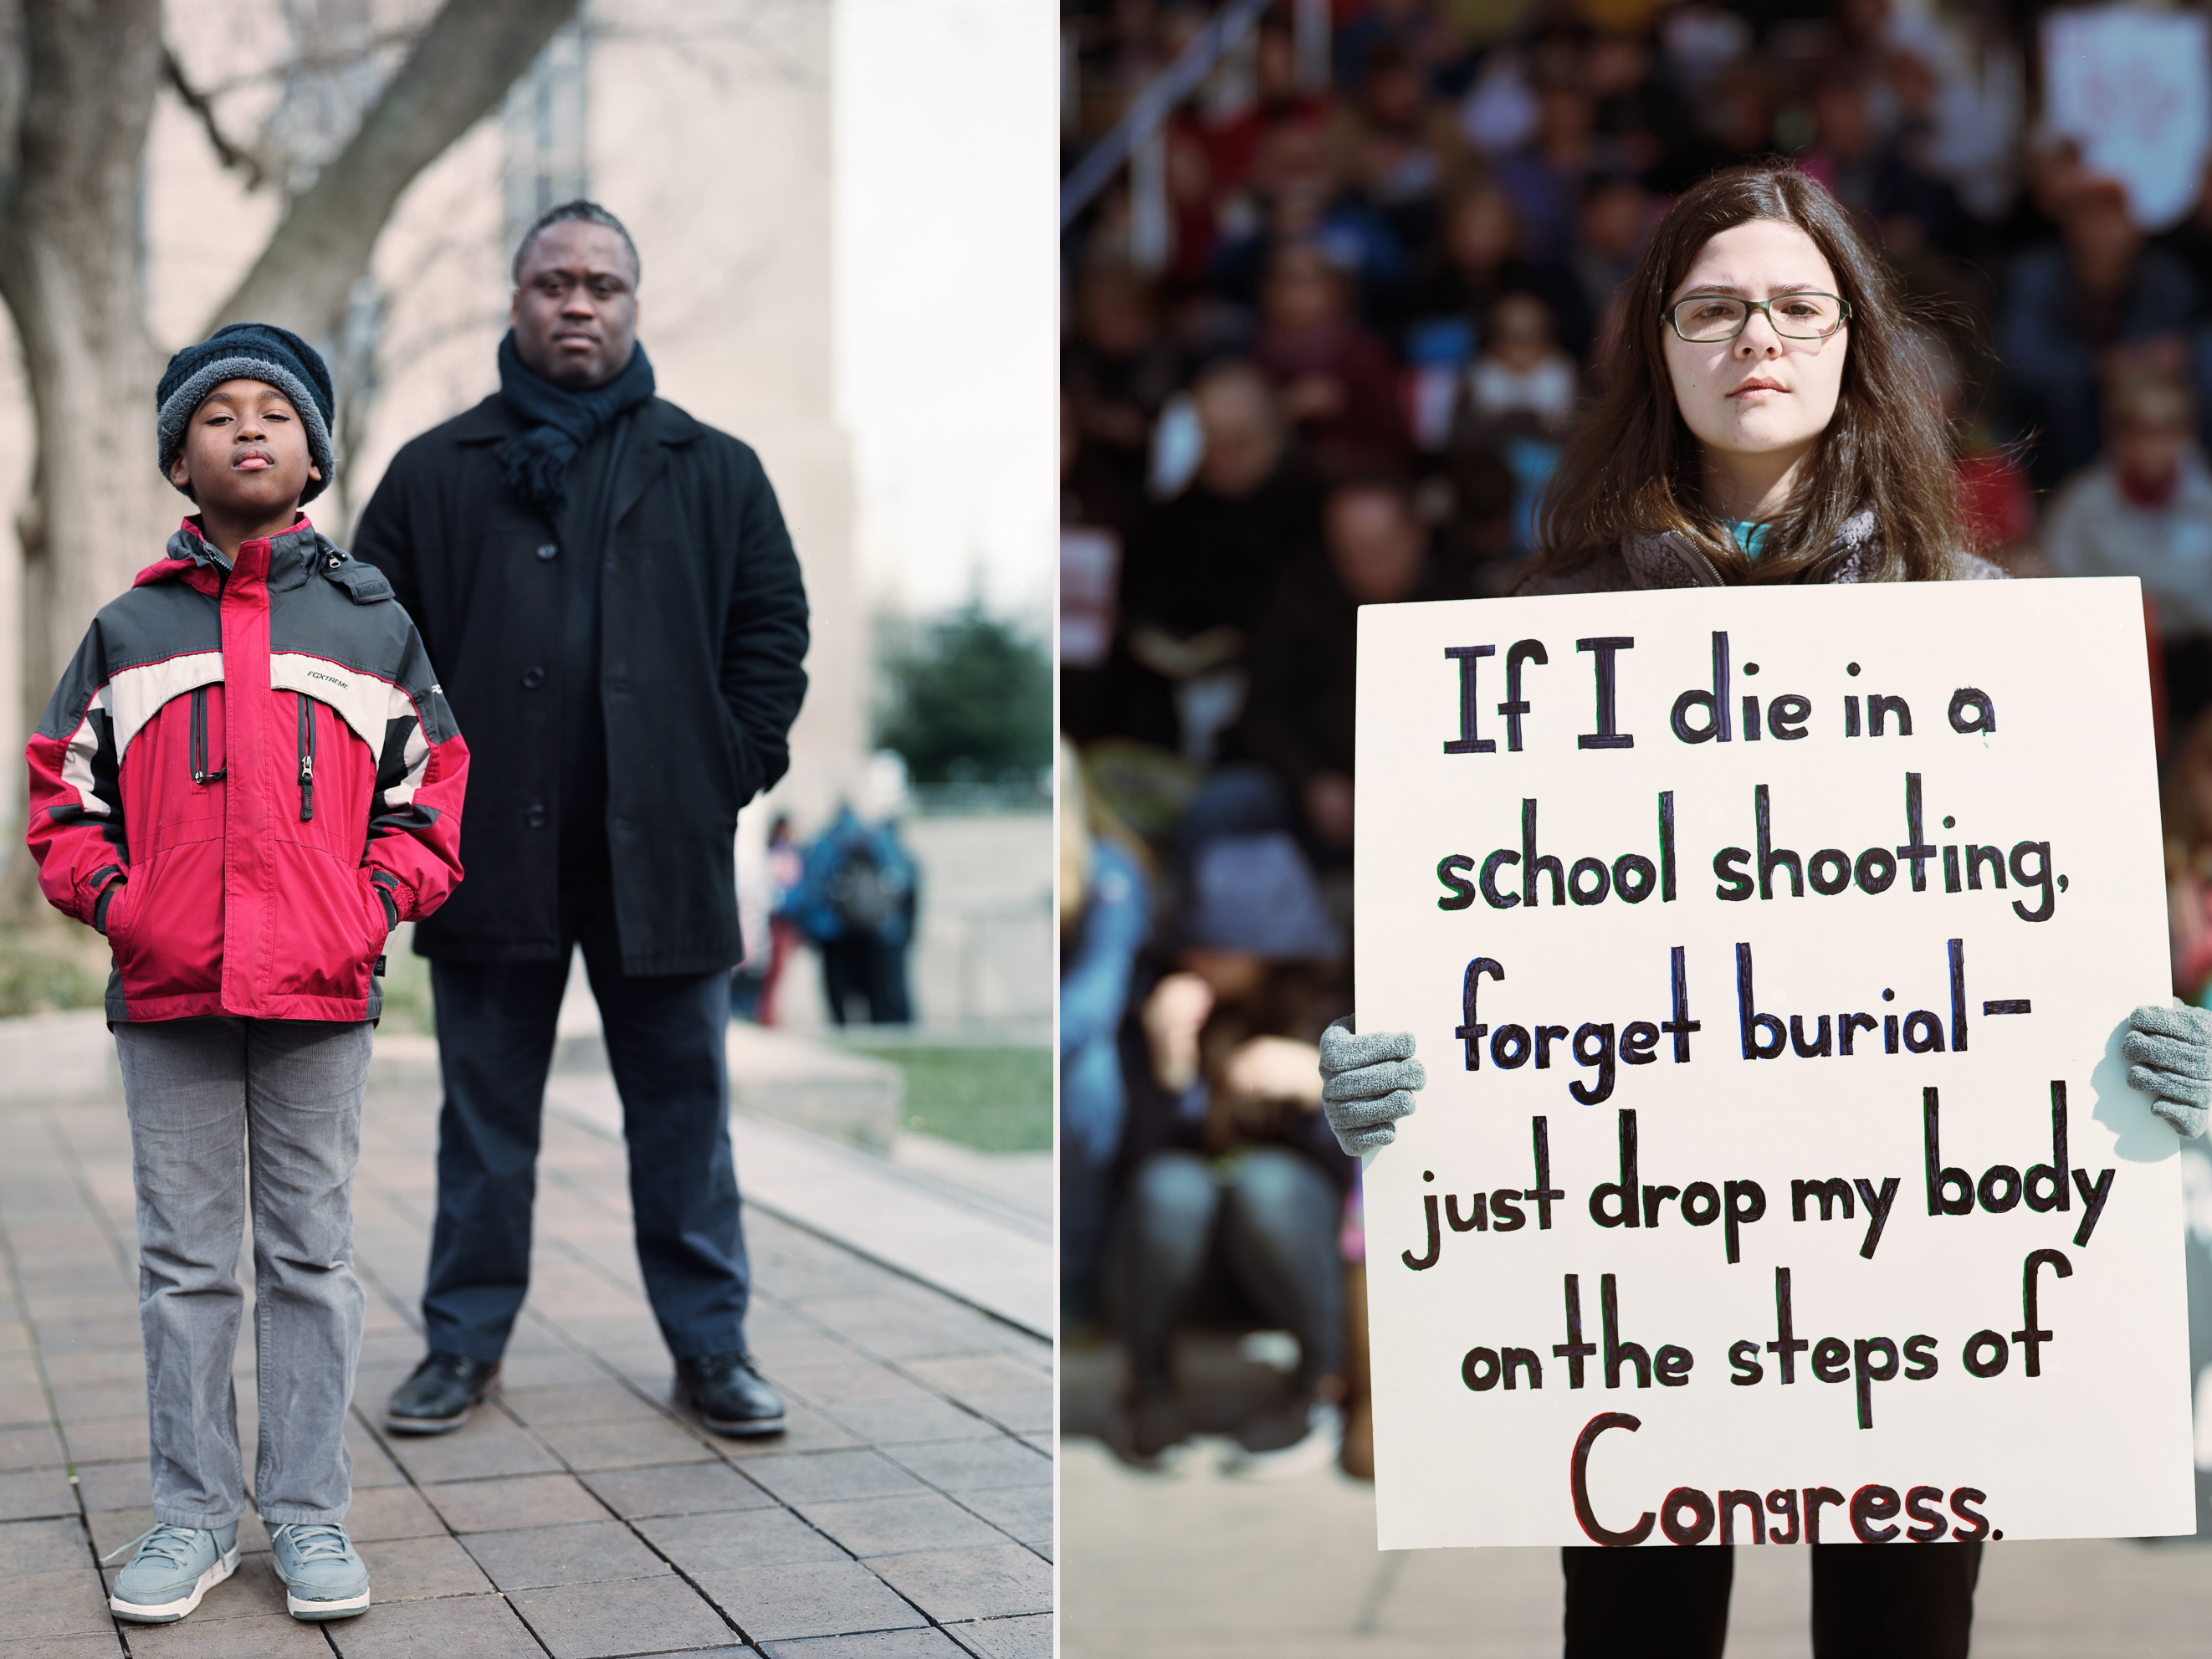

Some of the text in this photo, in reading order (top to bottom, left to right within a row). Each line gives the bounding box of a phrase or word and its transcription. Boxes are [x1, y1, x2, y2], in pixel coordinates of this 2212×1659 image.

[1443, 631, 1996, 754] If I die in a
[1437, 772, 2070, 922] school shooting,
[1455, 939, 2031, 1106] forget burial-
[1401, 1080, 2116, 1271] just drop my body
[1462, 1249, 2073, 1430] on the steps of
[1570, 1411, 2004, 1545] Congress.
